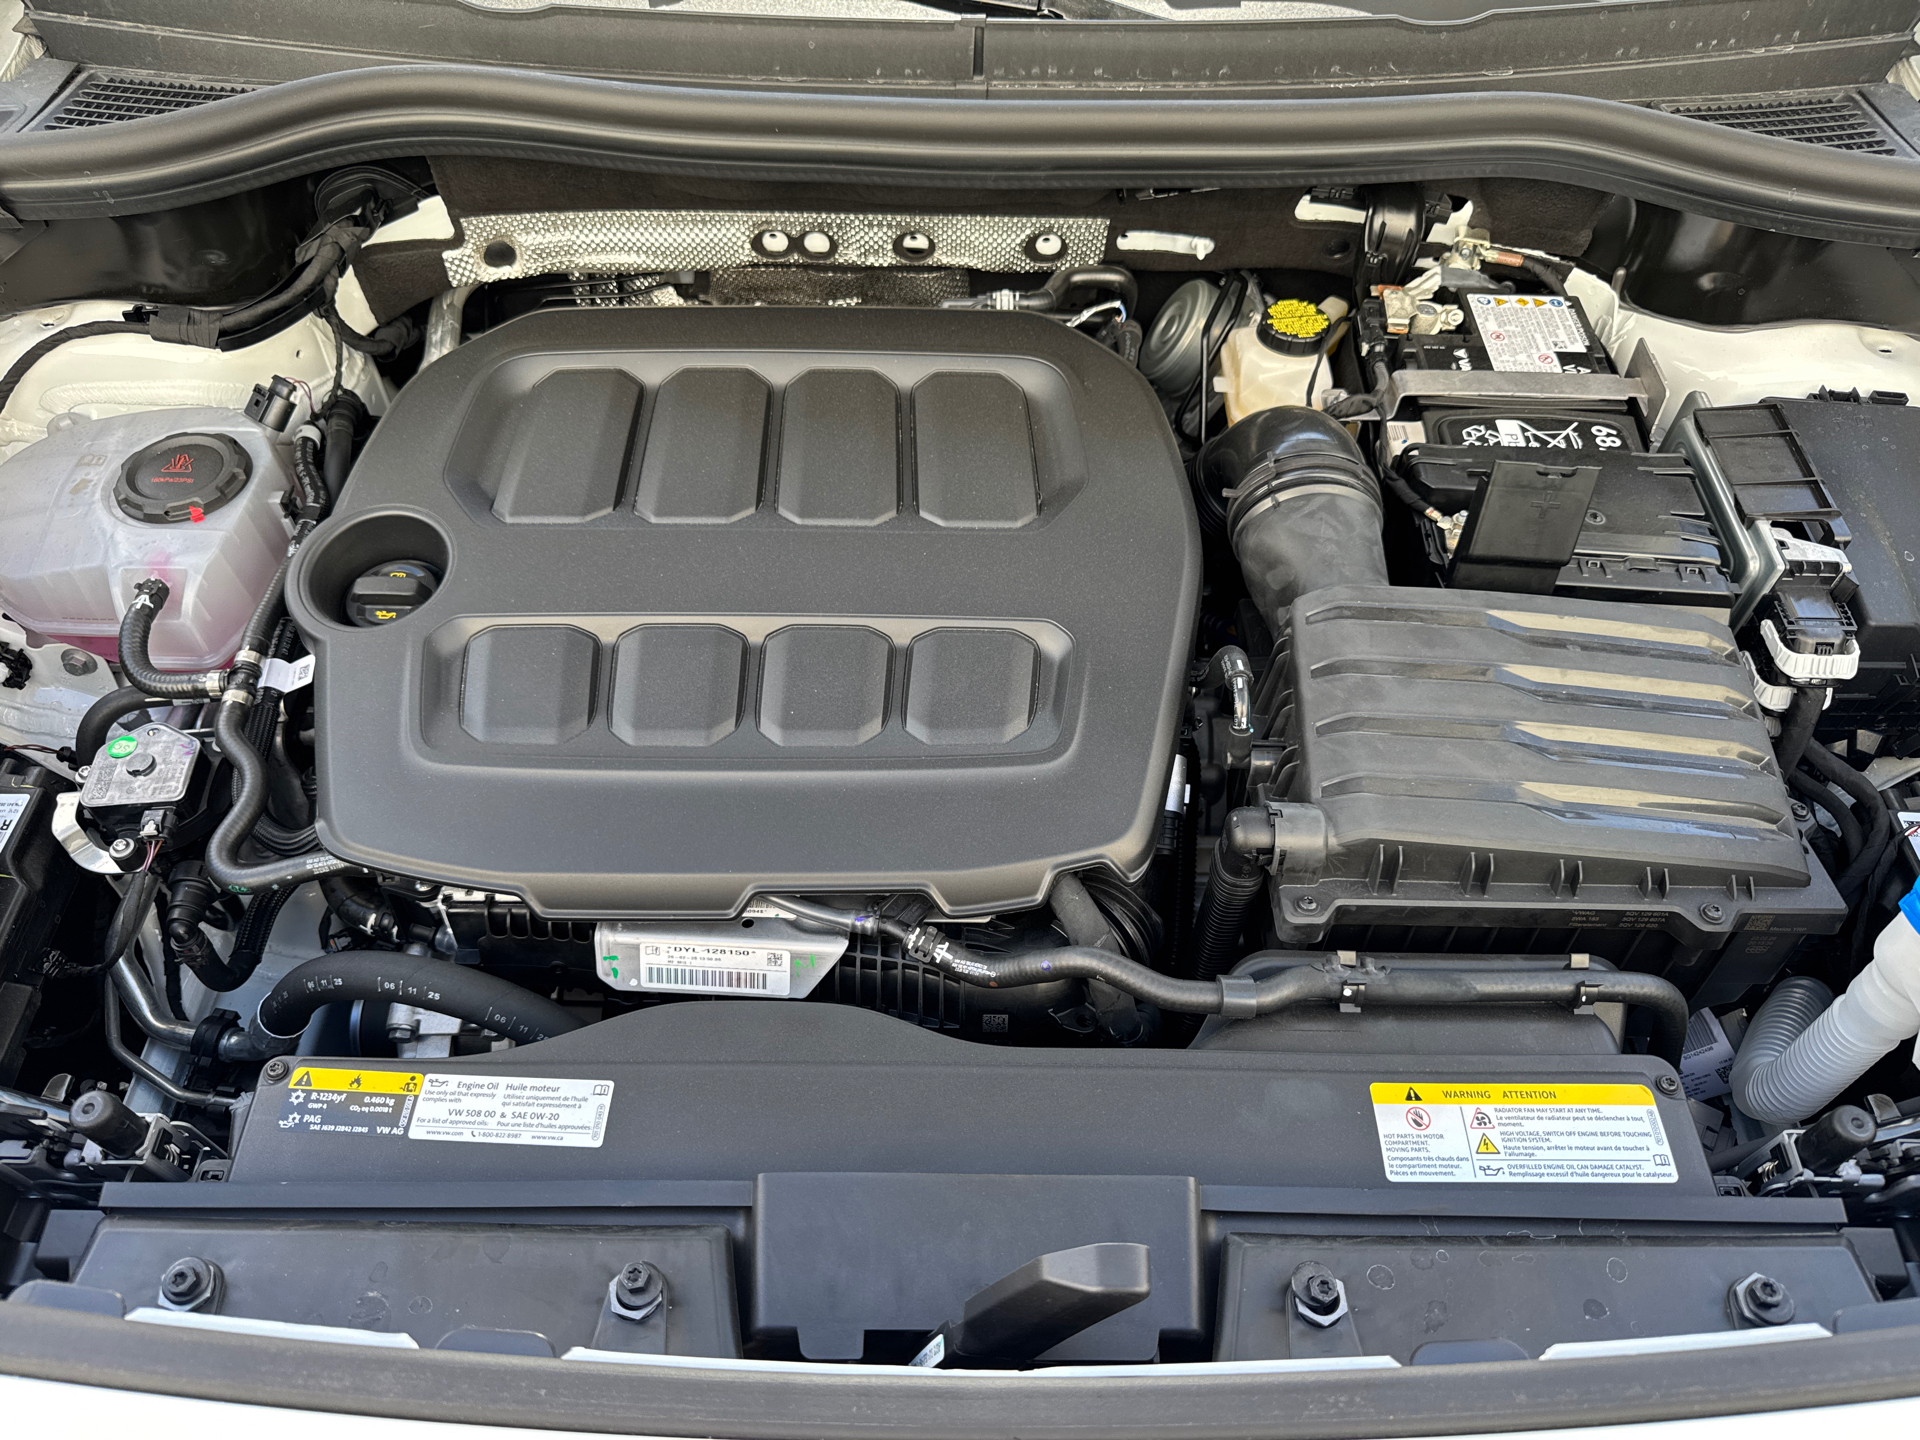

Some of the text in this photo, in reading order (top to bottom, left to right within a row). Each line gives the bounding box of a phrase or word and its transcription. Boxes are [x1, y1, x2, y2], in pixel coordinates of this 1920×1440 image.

[384, 982, 441, 1000] 06 11 25
[494, 1014, 507, 1024] 06
[518, 1024, 528, 1034] 11
[457, 1081, 499, 1091] Engine Oil
[506, 1083, 560, 1092] Huile moteur
[310, 1092, 396, 1106] R-1234yf 0.460 kg
[469, 1091, 496, 1099] expressly
[1442, 1090, 1557, 1099] WARNING ATTENTION
[303, 1114, 322, 1123] PAG
[448, 1108, 464, 1117] VW
[483, 1110, 496, 1118] 00
[511, 1111, 528, 1119] SAE
[530, 1112, 560, 1120] 0W-20
[376, 1126, 391, 1134] VW
[391, 1127, 404, 1135] AG
[478, 1131, 522, 1139] 1-800-822-8987
